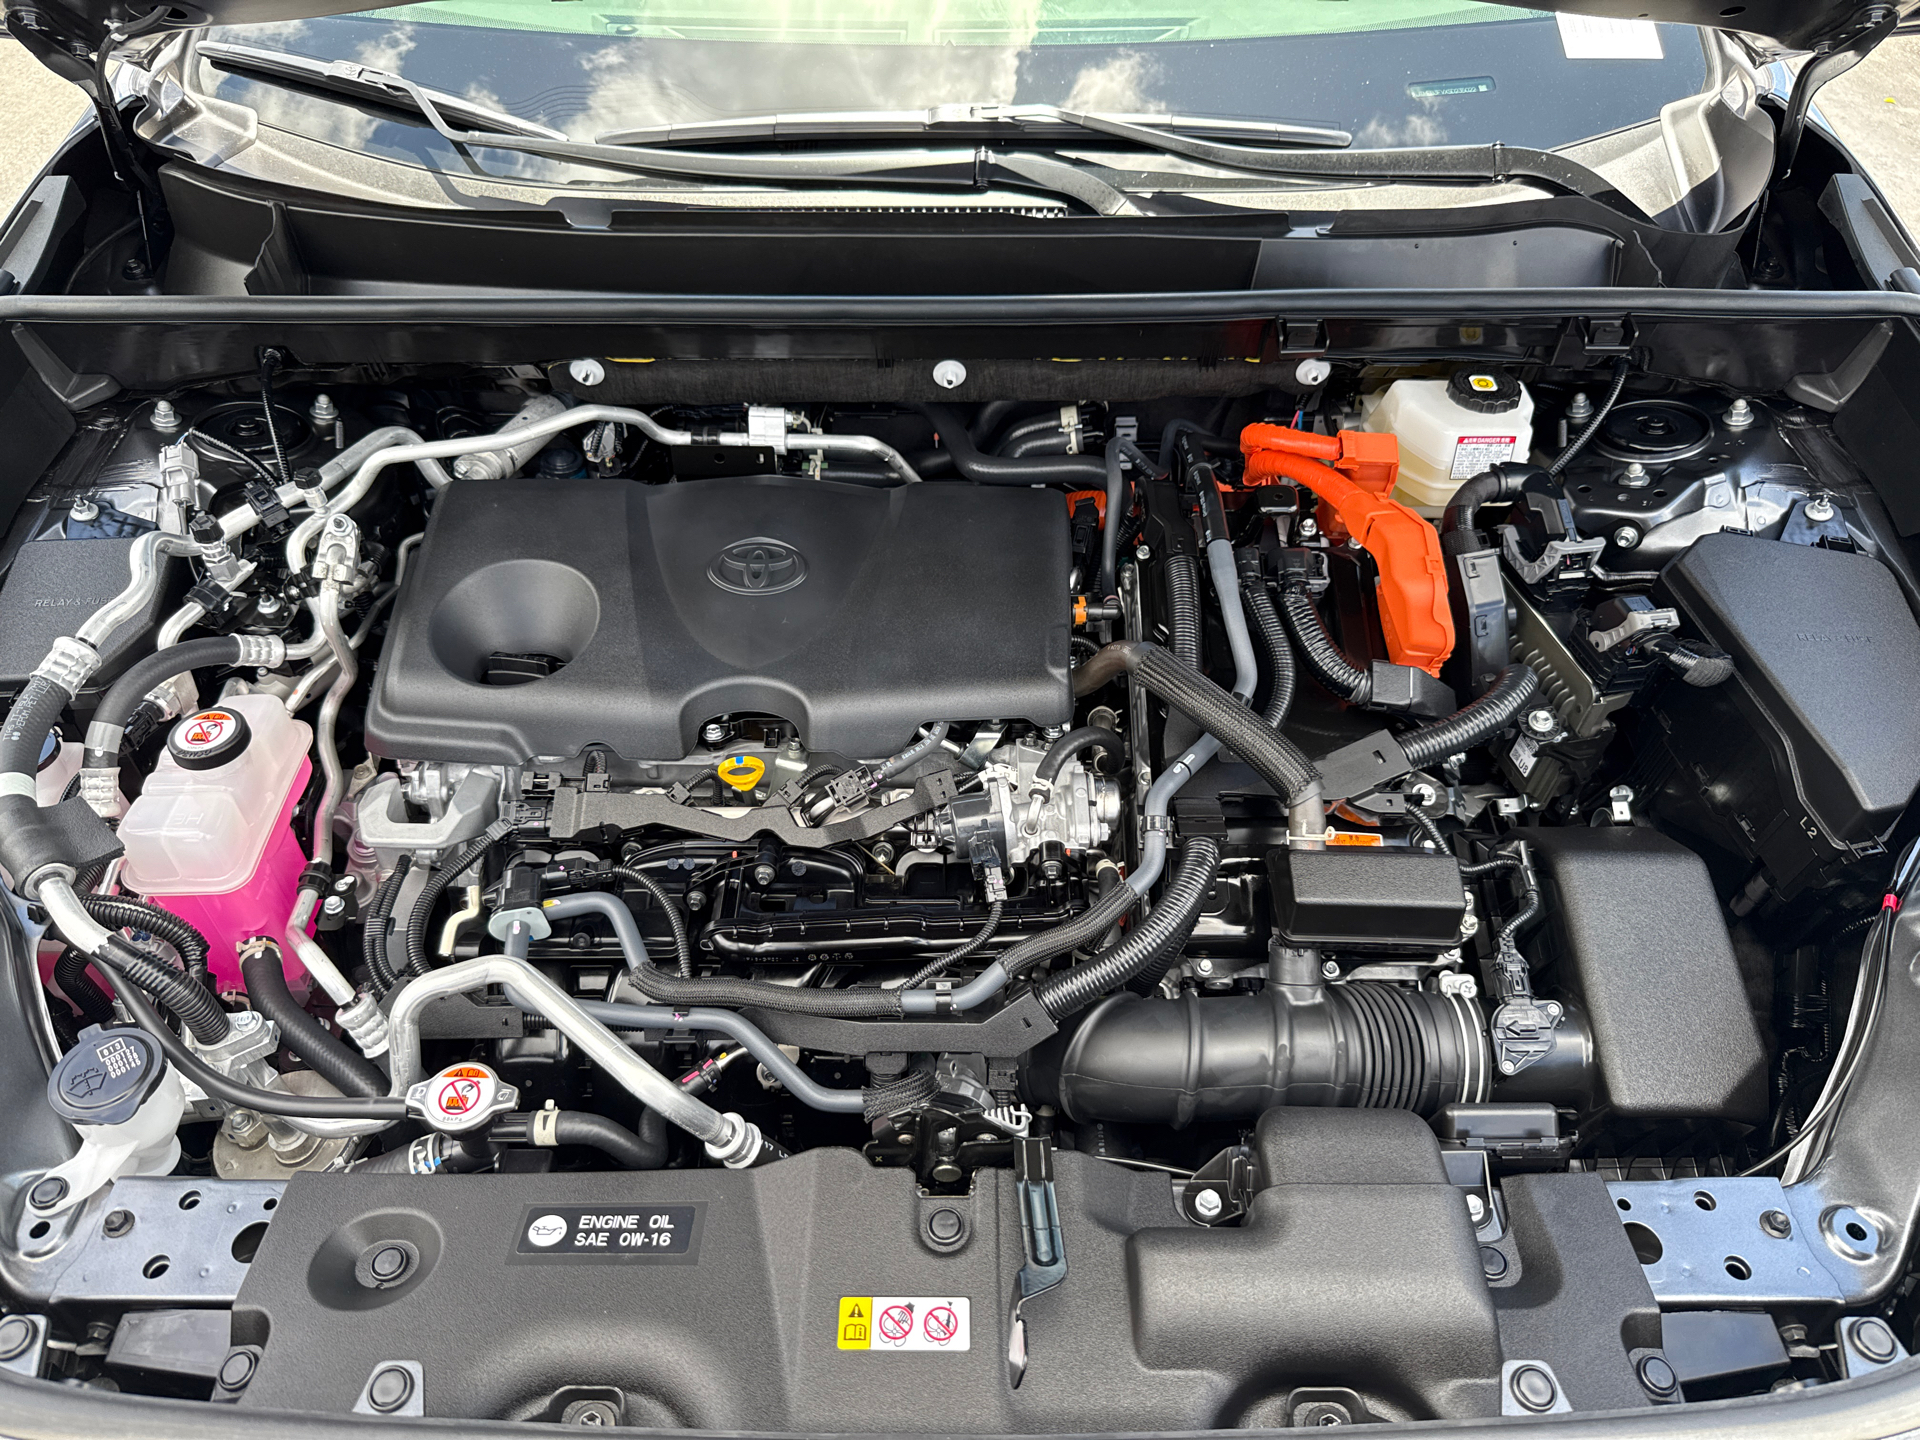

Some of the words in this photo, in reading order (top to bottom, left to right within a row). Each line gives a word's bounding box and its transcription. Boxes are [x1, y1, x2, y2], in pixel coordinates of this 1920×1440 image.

[34, 598, 73, 607] RELAY
[578, 1215, 640, 1229] ENGINE
[649, 1215, 675, 1229] OIL
[574, 1232, 610, 1247] SAE
[618, 1232, 672, 1247] 0W-16
